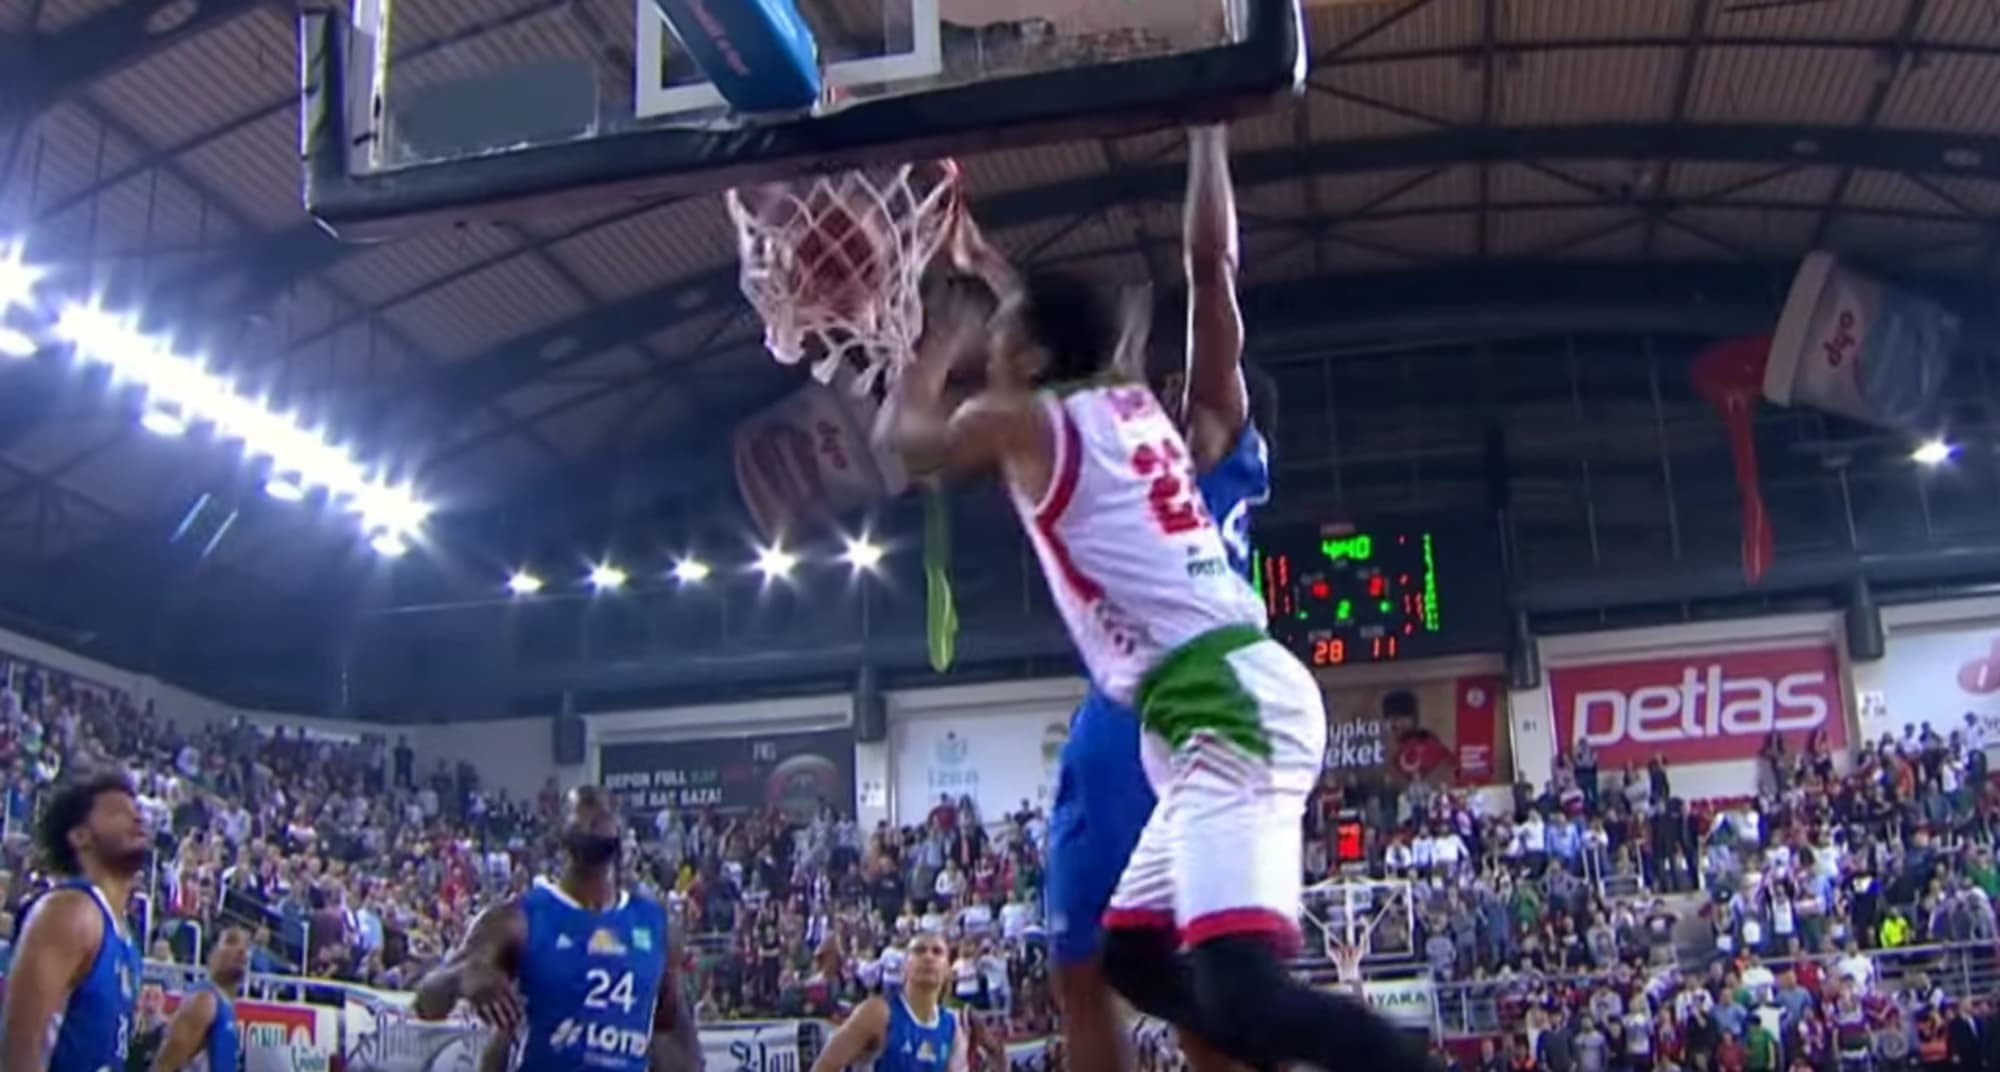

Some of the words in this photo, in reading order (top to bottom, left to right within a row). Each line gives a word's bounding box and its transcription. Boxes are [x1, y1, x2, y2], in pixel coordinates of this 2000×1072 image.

[1314, 640, 1344, 665] 28
[1373, 637, 1396, 657] 11
[1573, 665, 1828, 746] petlas
[584, 968, 637, 1014] 24
